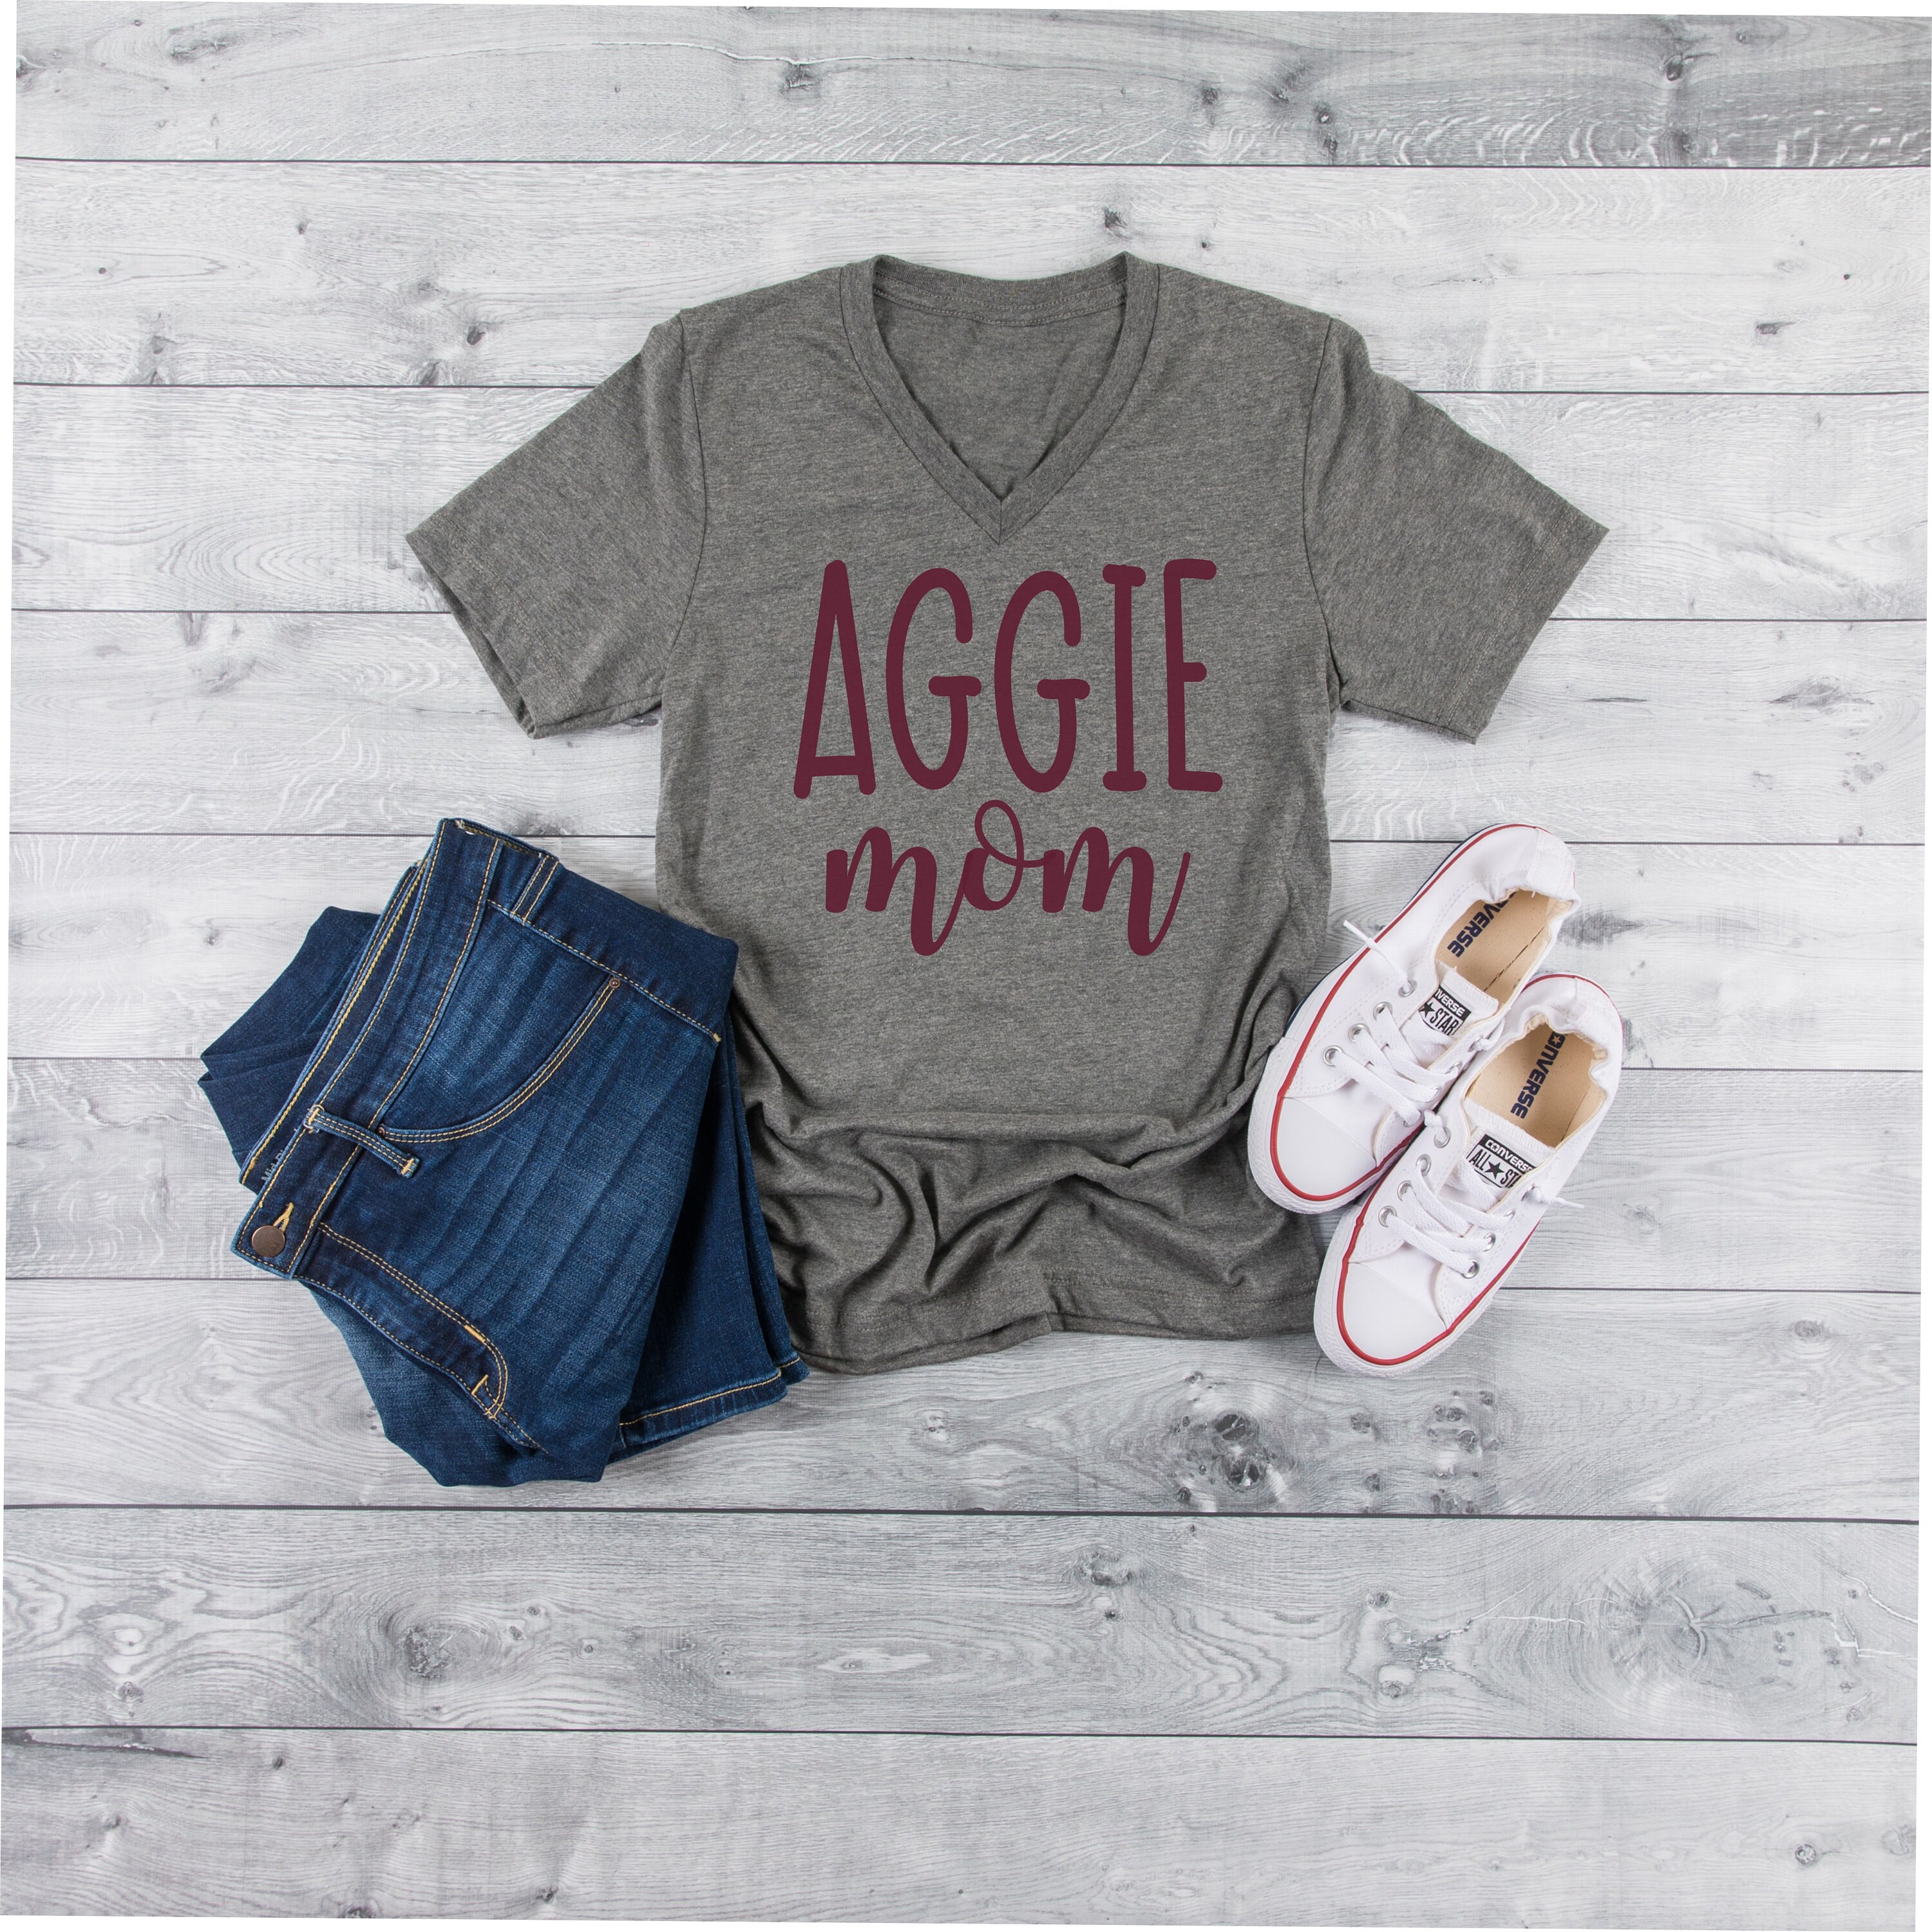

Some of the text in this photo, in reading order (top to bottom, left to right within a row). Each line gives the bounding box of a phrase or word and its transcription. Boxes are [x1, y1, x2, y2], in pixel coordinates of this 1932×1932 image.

[793, 558, 1223, 799] AGGIE
[825, 800, 1191, 956] mom
[1430, 1008, 1459, 1036] STAR
[1510, 1031, 1568, 1119] ONVERSE
[1469, 1149, 1491, 1171] ALL
